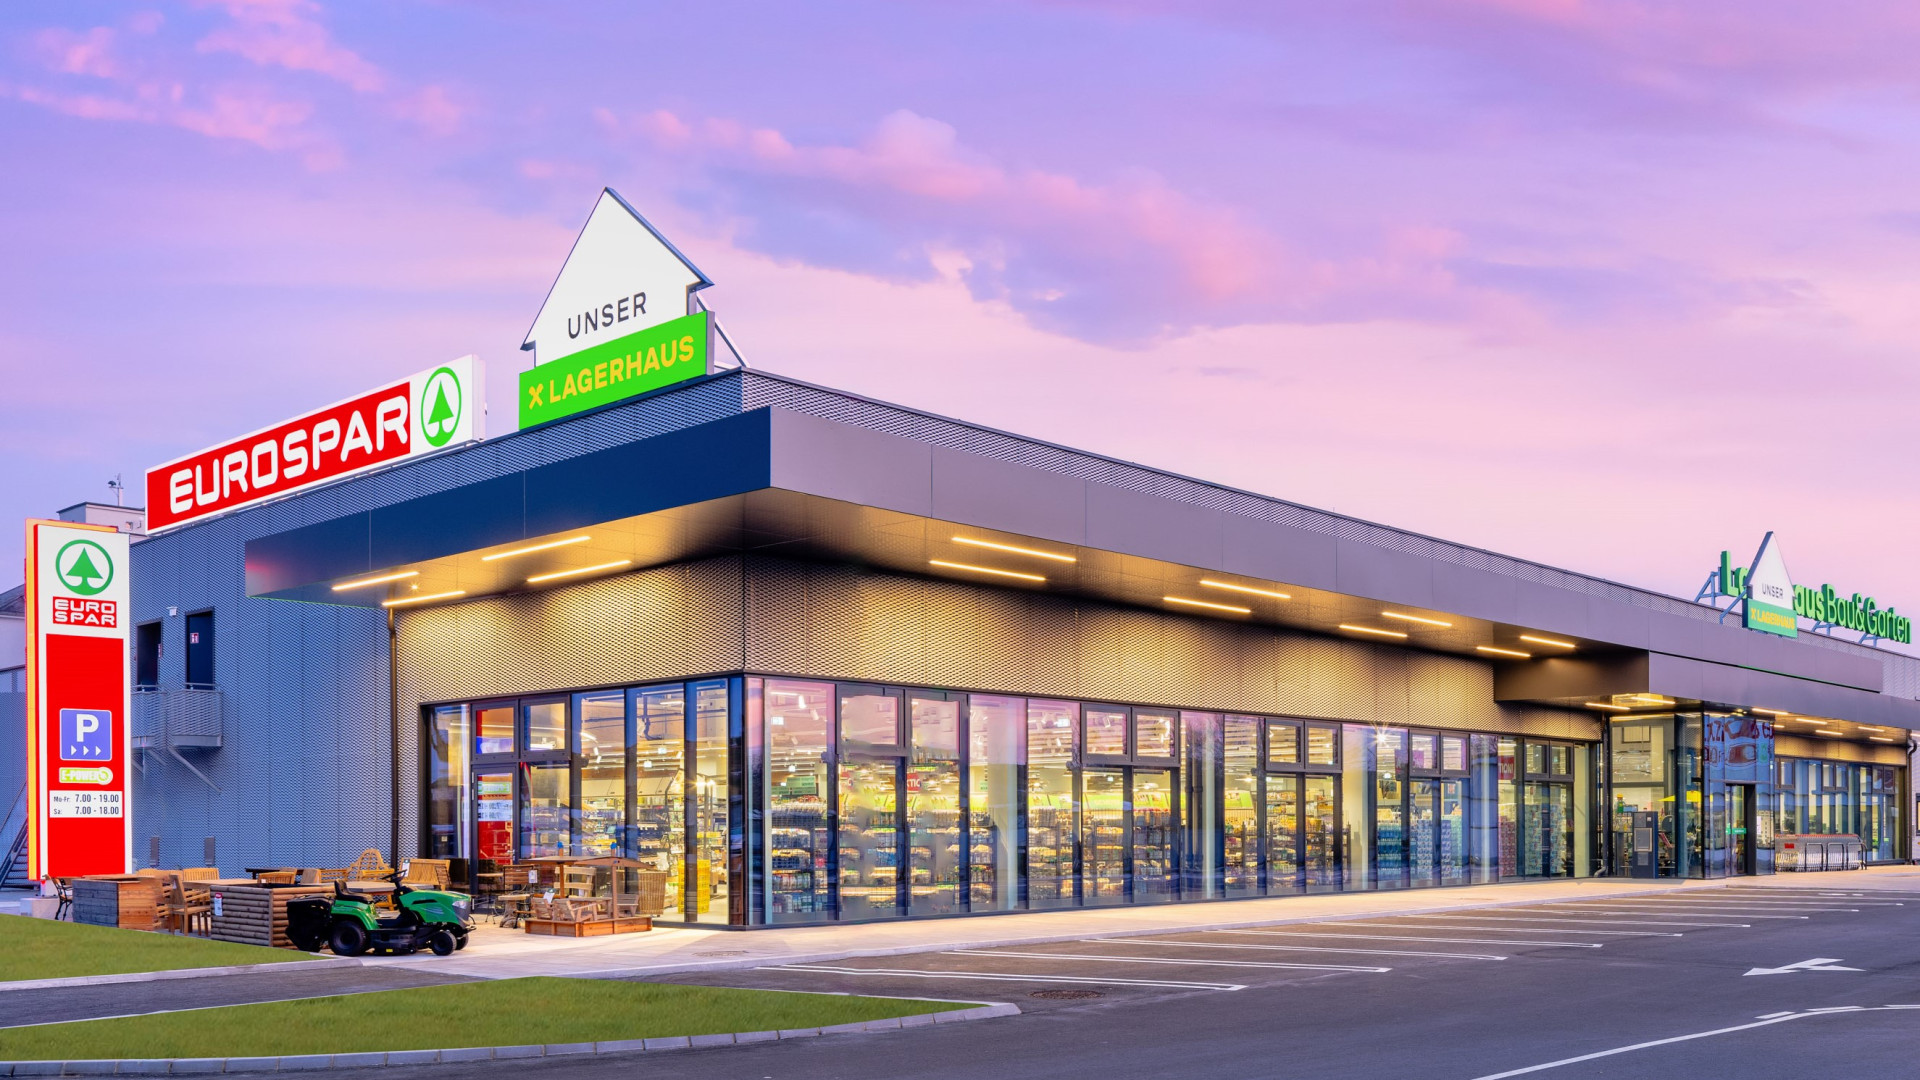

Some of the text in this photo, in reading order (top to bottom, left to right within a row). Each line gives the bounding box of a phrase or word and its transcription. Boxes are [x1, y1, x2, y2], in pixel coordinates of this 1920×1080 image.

[567, 291, 647, 339] UNSER
[549, 335, 695, 404] LAGERHAUS
[169, 395, 409, 515] EUROSPAR
[1761, 582, 1784, 600] UNSER
[54, 598, 116, 614] EURO
[54, 610, 116, 626] SPAR
[1756, 608, 1796, 631] LAGERHAUS
[76, 713, 99, 743] P
[75, 793, 92, 803] 7.00
[99, 794, 120, 803] 19.00
[75, 806, 92, 815] 7.00
[99, 806, 120, 815] 18.00
